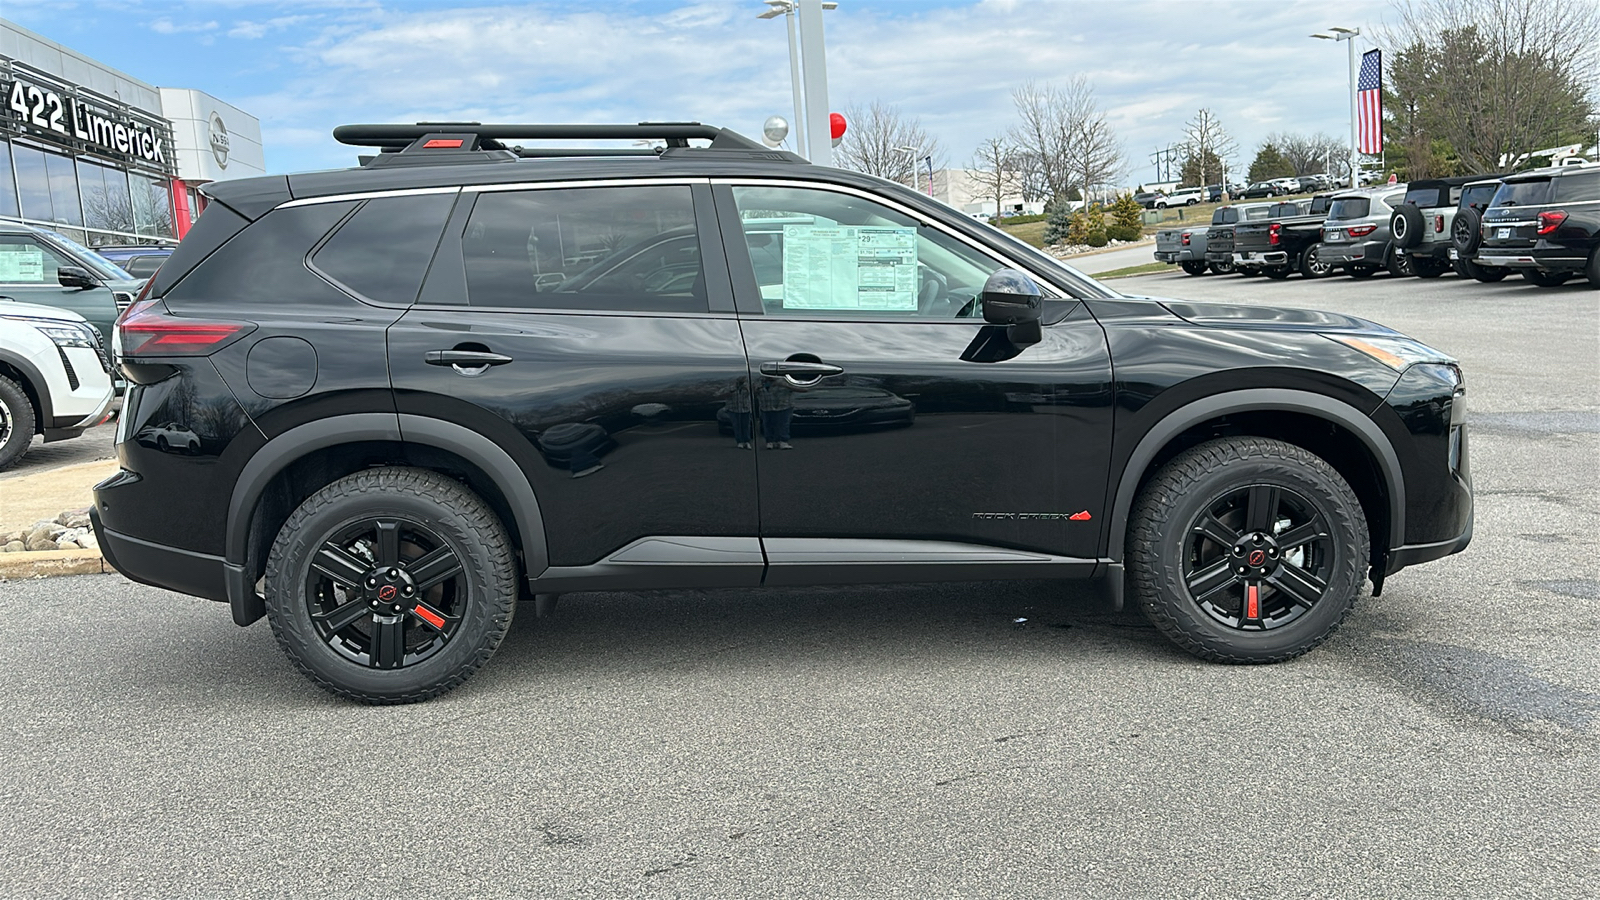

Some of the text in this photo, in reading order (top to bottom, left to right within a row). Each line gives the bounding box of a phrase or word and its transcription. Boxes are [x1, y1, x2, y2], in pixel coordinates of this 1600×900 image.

[10, 81, 165, 164] 422 Limerick
[971, 512, 1070, 520] ROCK CREEK
